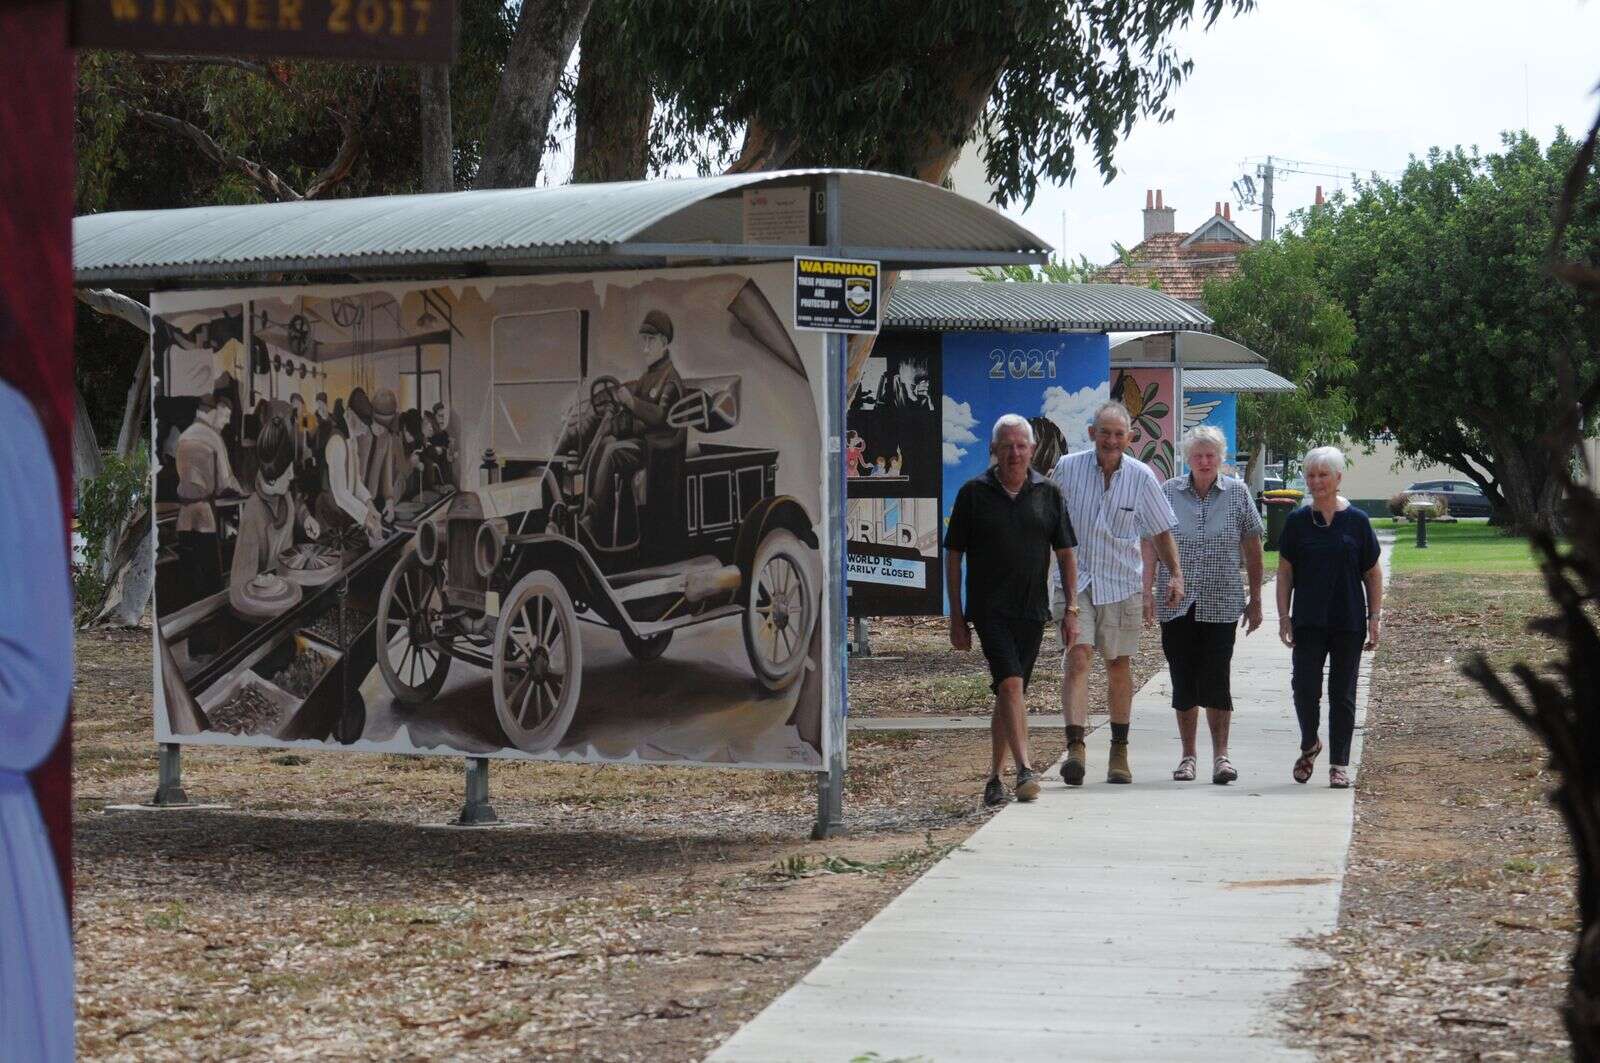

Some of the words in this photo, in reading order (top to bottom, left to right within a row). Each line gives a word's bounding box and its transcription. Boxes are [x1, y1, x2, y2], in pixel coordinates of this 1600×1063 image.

[111, 0, 303, 30] WINNER
[327, 0, 432, 35] 2017
[817, 193, 825, 211] 8
[800, 260, 877, 277] WARNING
[798, 276, 814, 286] THESE
[815, 277, 842, 288] PREMISES
[814, 288, 825, 298] ARE
[800, 298, 830, 309] PROTECTED
[831, 300, 839, 309] BY
[989, 348, 1057, 380] 2021
[847, 554, 880, 565] WORLD
[883, 557, 893, 567] IS
[881, 567, 915, 579] CLOSED
